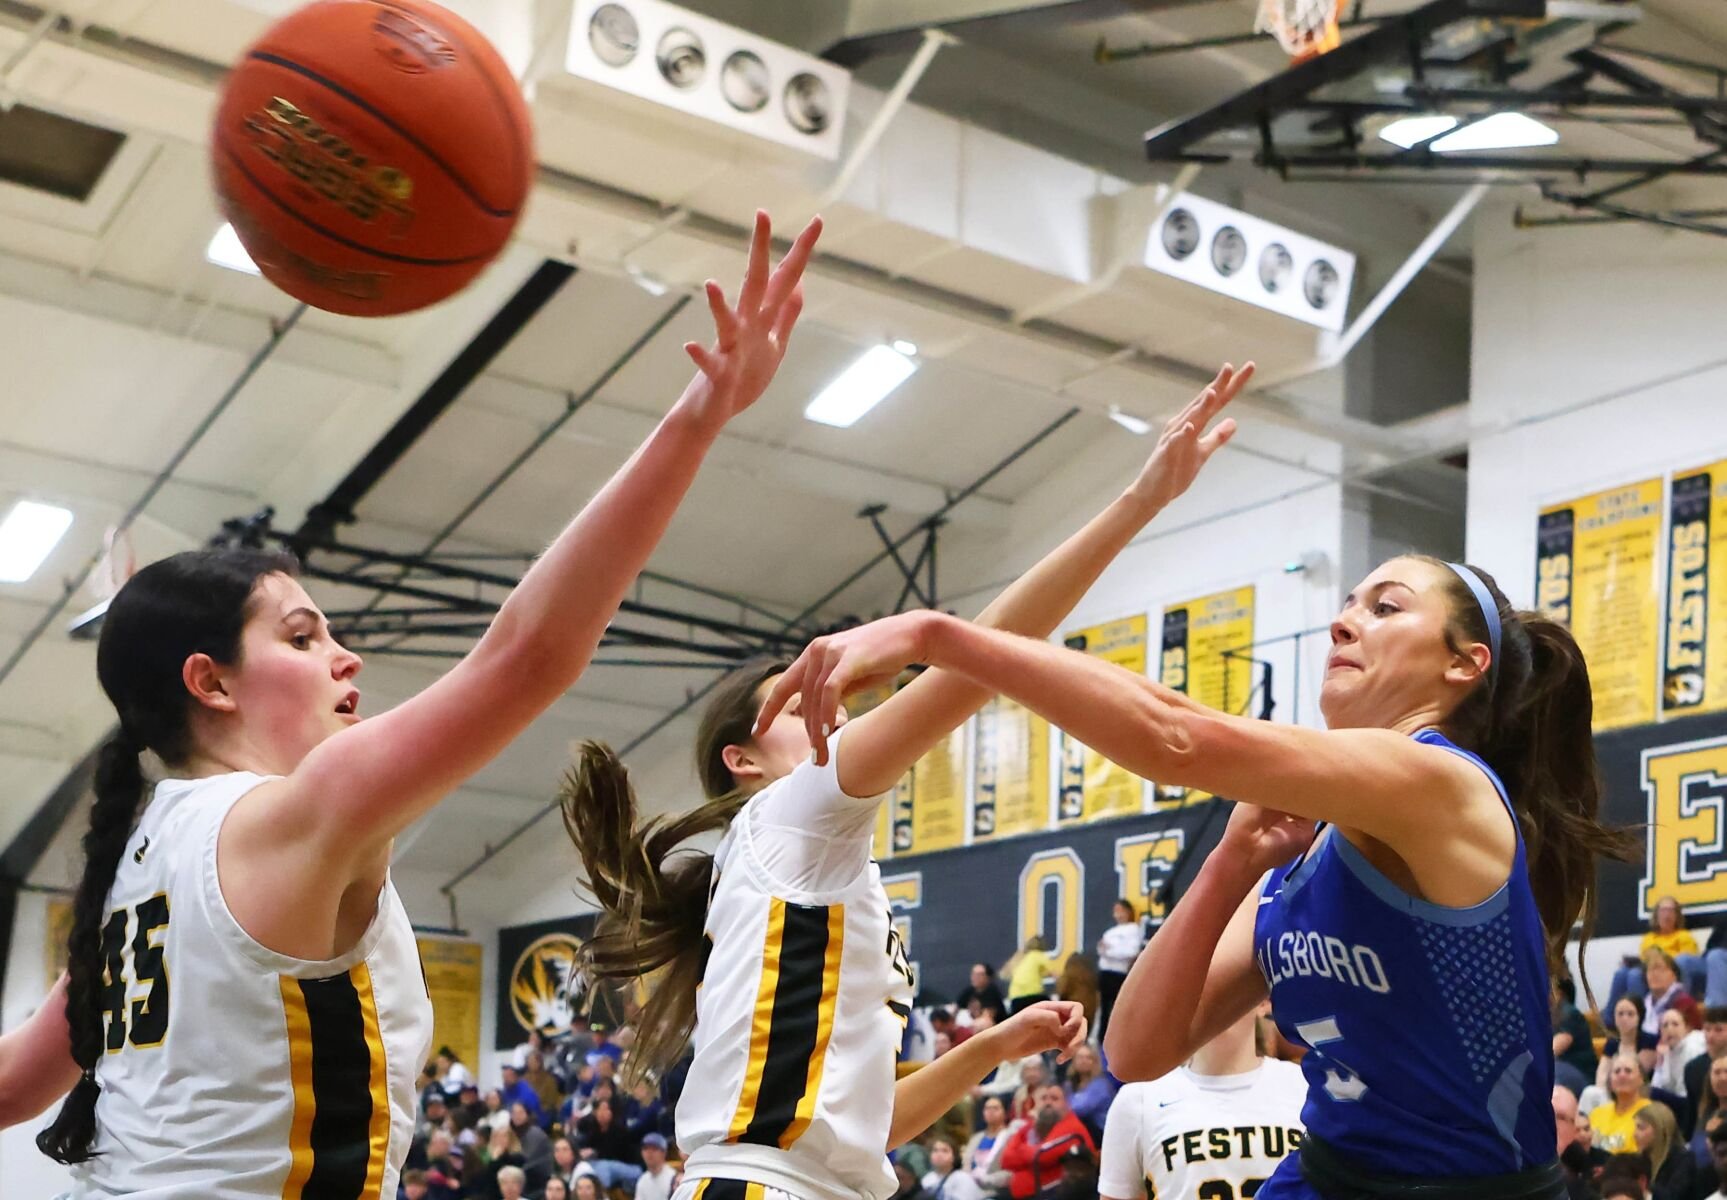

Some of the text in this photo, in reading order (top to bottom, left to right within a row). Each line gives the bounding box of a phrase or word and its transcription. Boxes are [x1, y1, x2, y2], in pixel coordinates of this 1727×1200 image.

[1536, 553, 1570, 623] TUS
[1668, 519, 1707, 670] FESTUS
[101, 890, 171, 1056] 45
[1295, 1015, 1369, 1102] 5
